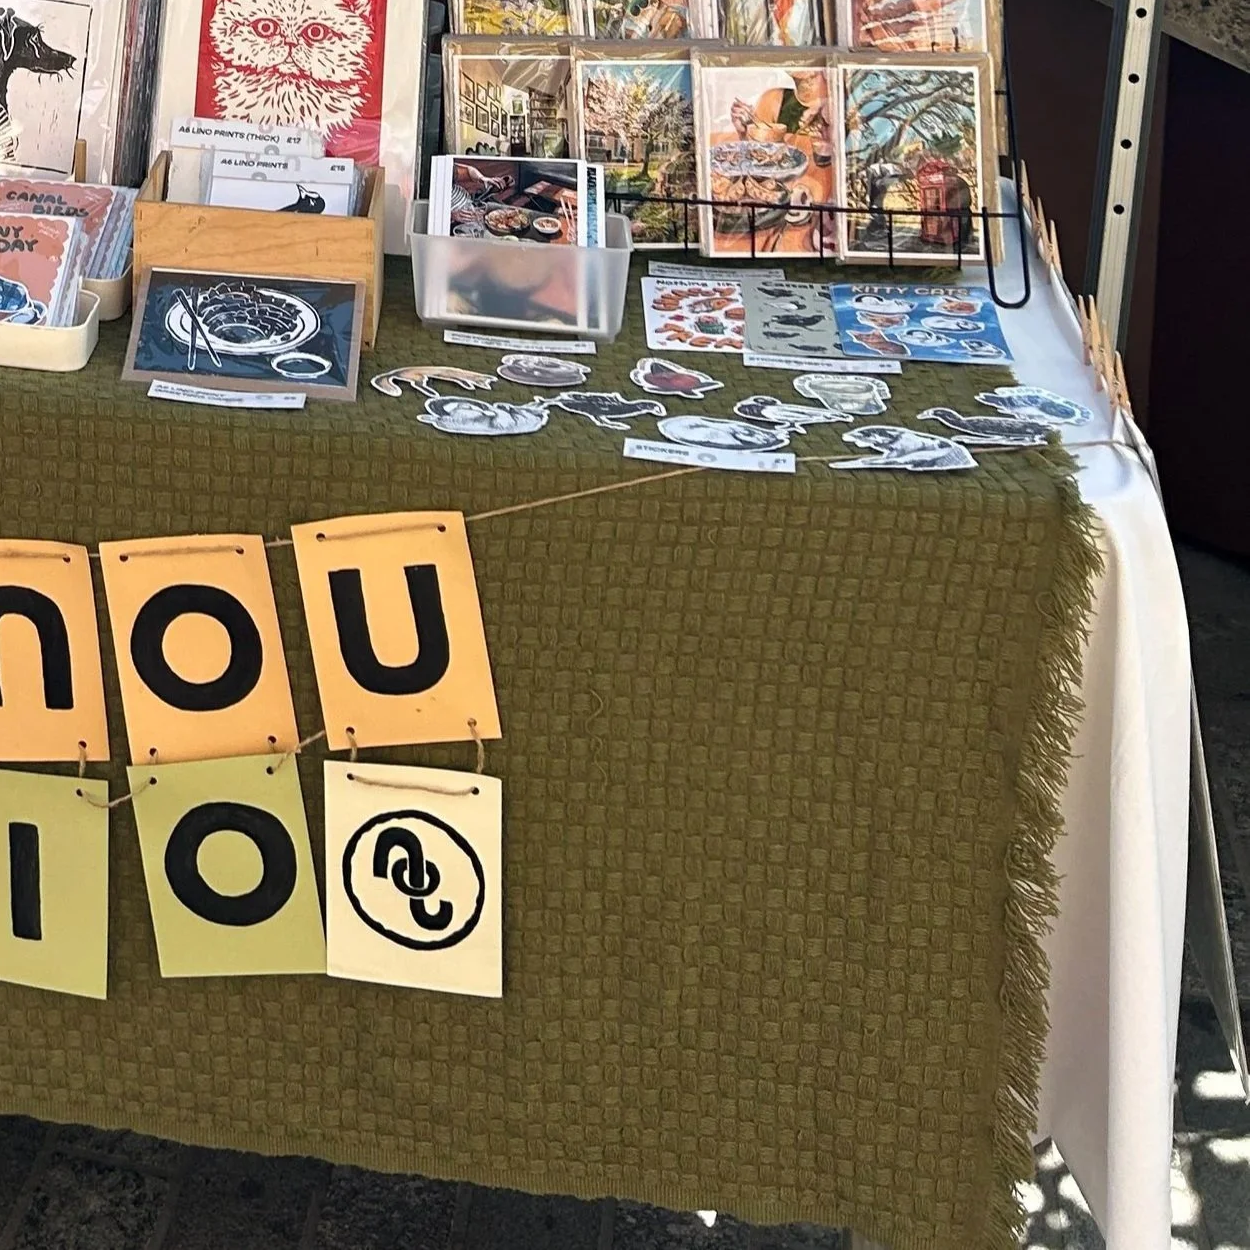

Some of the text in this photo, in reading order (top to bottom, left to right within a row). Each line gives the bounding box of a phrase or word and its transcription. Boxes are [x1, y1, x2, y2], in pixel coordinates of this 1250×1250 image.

[178, 125, 301, 145] A6 LINO PRINTS (THICK) £17
[220, 157, 289, 170] A6 LINO PRINTS
[5, 190, 68, 206] CANAL
[32, 205, 90, 217] BIRDS
[761, 281, 814, 291] Canal
[851, 285, 970, 297] KITTY CATS
[635, 444, 689, 455] STICKERS
